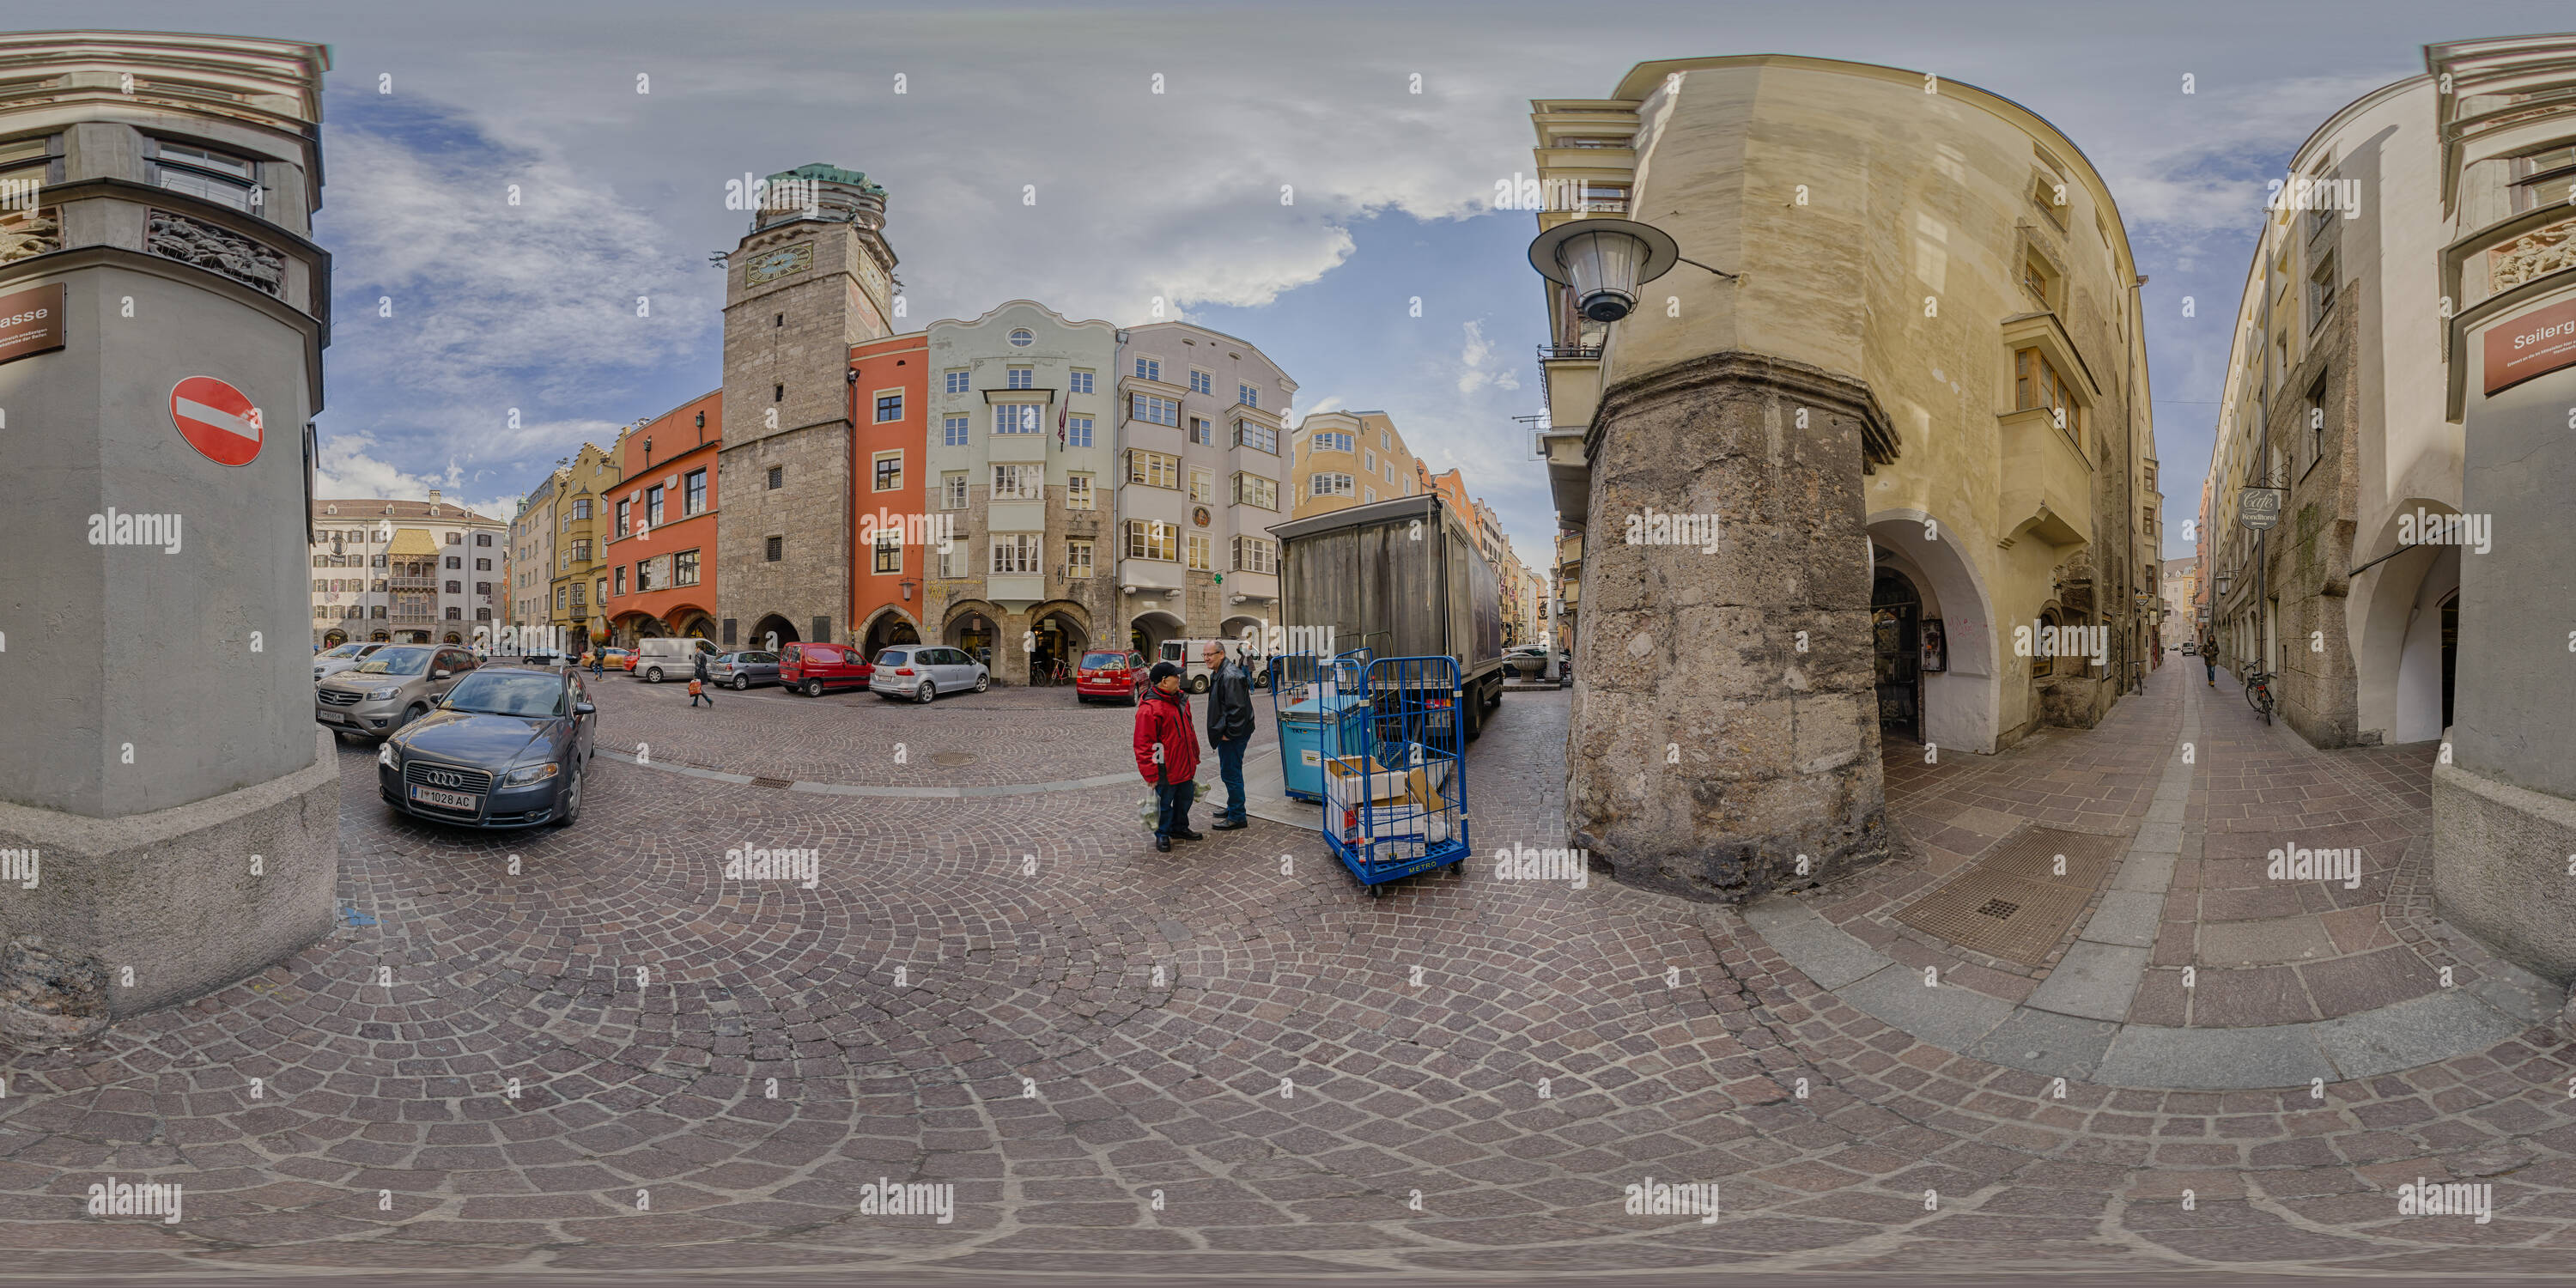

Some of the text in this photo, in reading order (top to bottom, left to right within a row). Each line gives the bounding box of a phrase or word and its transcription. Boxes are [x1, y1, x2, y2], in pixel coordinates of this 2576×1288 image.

[2514, 320, 2574, 349] Seilerg
[431, 792, 453, 805] 1028
[456, 796, 469, 806] AC
[1409, 861, 1437, 873] METRO
